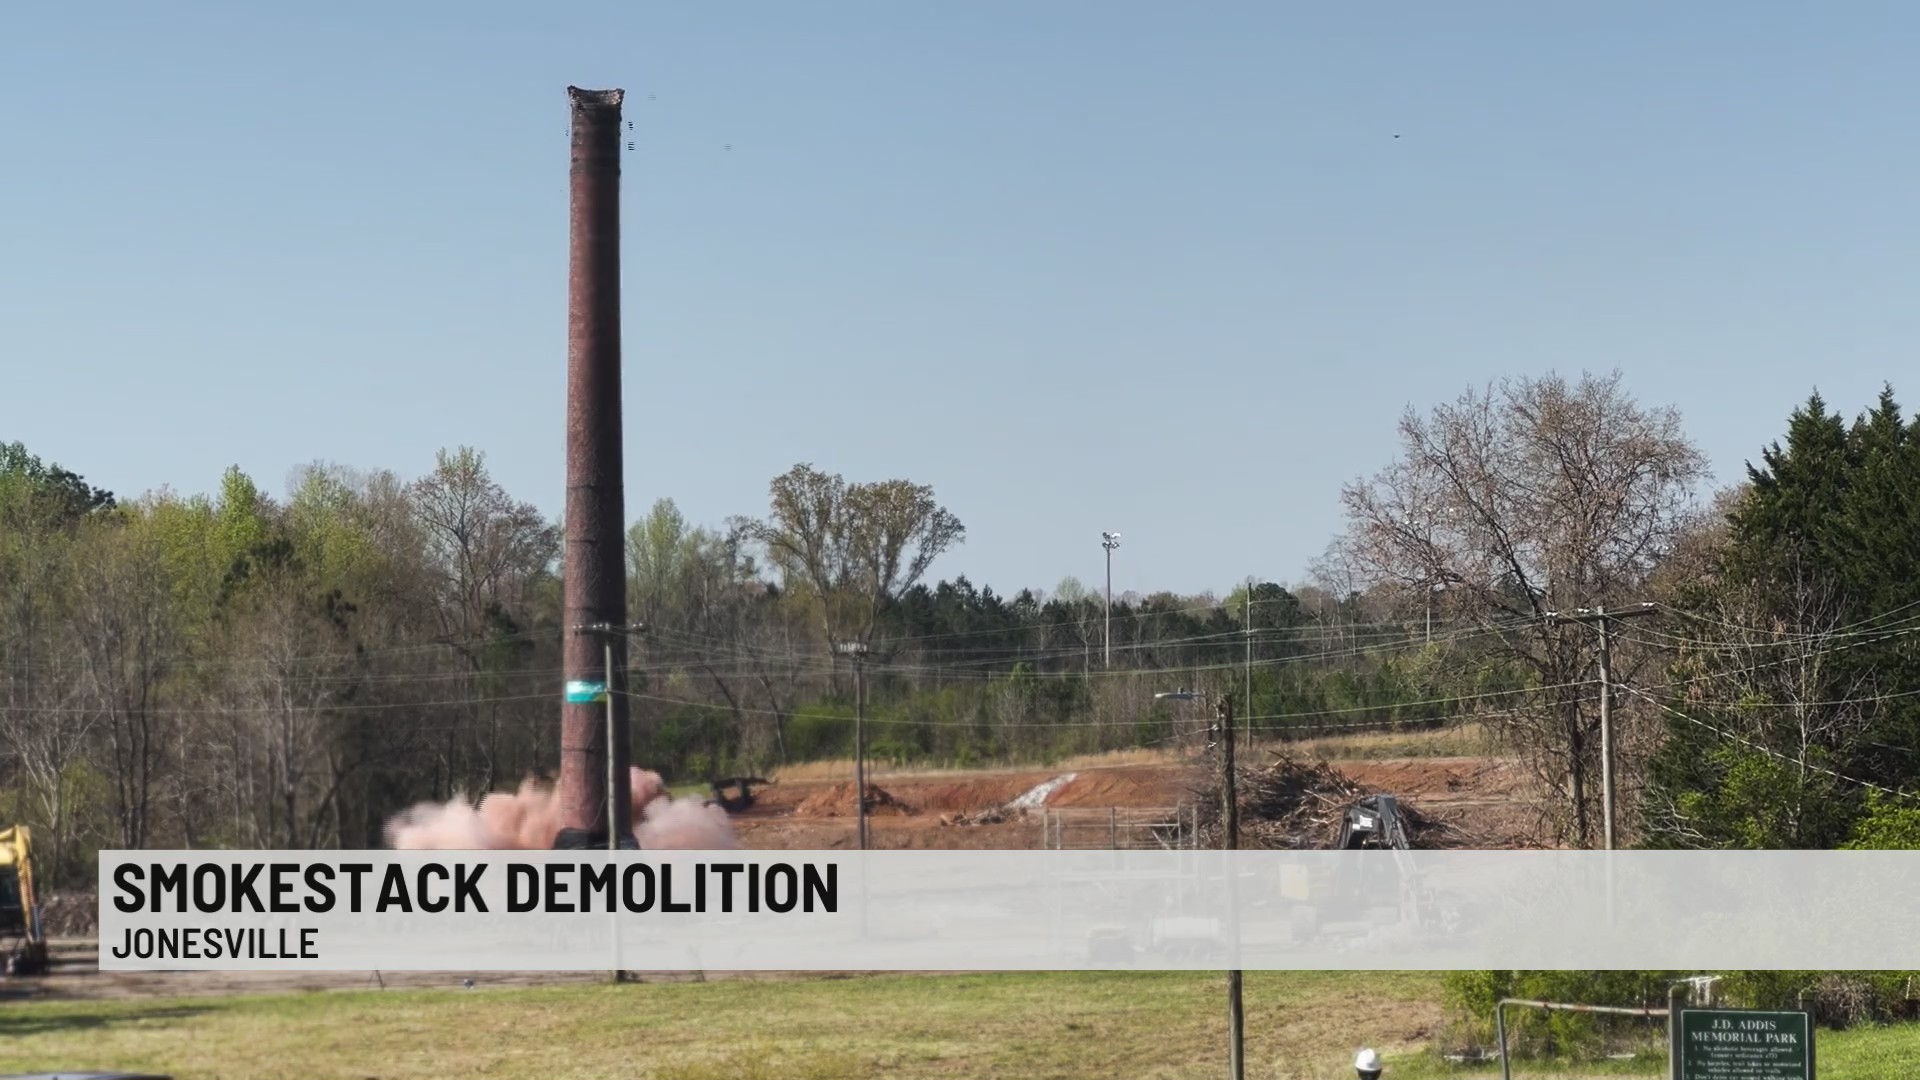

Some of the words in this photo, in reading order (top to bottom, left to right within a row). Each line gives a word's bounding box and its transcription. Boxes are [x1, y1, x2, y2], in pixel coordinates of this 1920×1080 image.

[1712, 1019, 1734, 1030] J.D.
[1739, 1020, 1777, 1030] ADDIS
[1692, 1031, 1761, 1042] MEMORIAL
[1766, 1033, 1797, 1043] PARK
